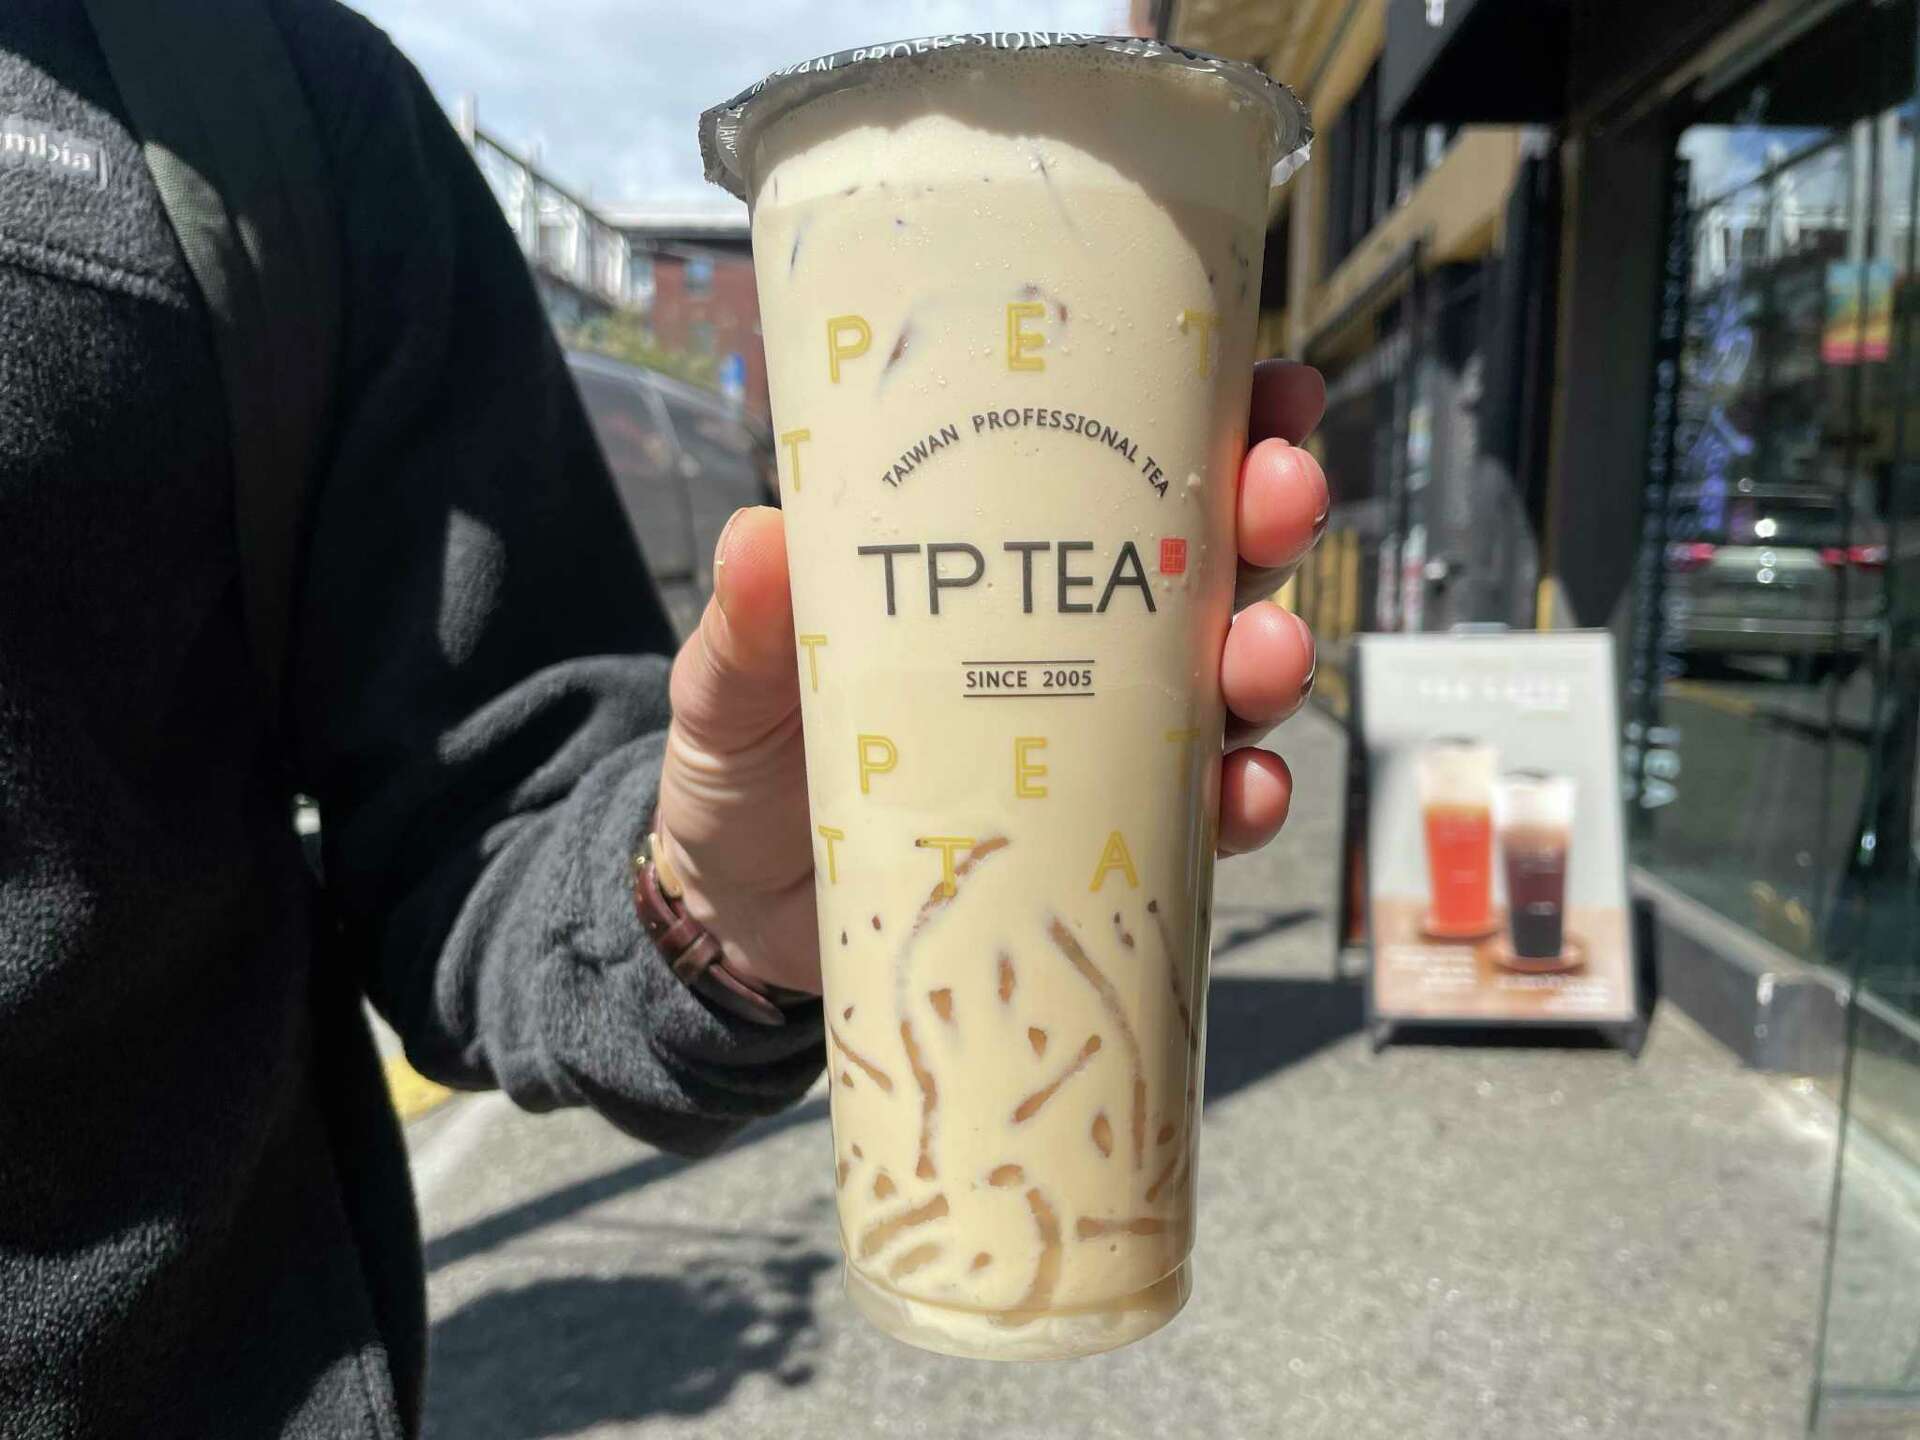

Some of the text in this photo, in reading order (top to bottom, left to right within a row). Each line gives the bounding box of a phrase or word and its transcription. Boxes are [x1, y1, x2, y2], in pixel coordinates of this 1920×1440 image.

[0, 132, 91, 172] mbia
[827, 314, 873, 384] P
[1006, 302, 1045, 372] E
[782, 429, 811, 492] T
[881, 407, 1170, 498] TAIWAN PROFESSIONAL TEA
[858, 542, 986, 616] TP
[1003, 541, 1157, 614] TEA
[799, 634, 828, 692] T
[965, 669, 1093, 689] SINCE 2005
[857, 734, 898, 795] P
[1013, 736, 1048, 799] E
[818, 825, 1140, 898] T T A
